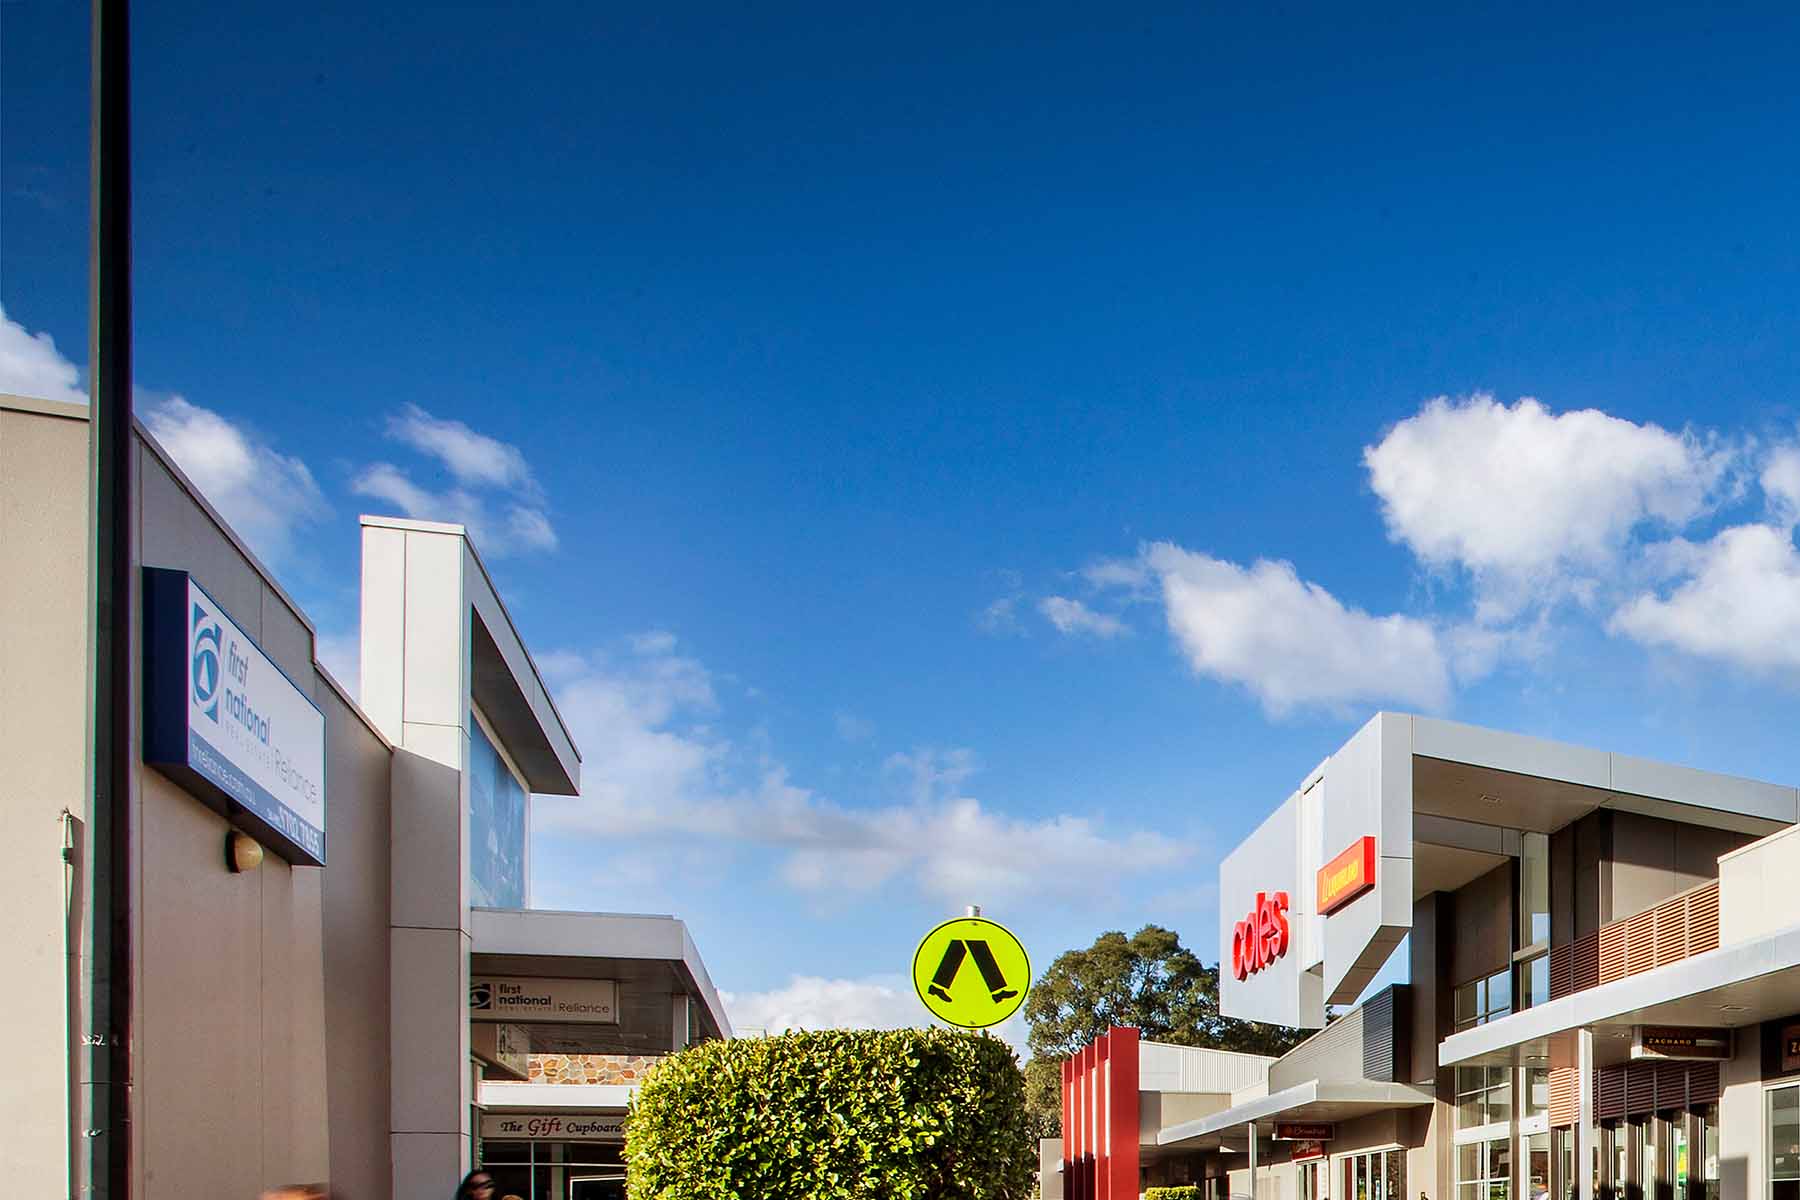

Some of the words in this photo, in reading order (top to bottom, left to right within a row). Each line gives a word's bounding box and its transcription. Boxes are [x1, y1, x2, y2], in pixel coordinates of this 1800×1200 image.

[229, 641, 249, 687] first
[225, 687, 271, 746] national
[1232, 890, 1289, 981] coles
[499, 984, 521, 994] first
[499, 995, 552, 1006] national
[559, 1002, 610, 1013] Reliance
[500, 1121, 523, 1132] The
[528, 1117, 562, 1136] Gift
